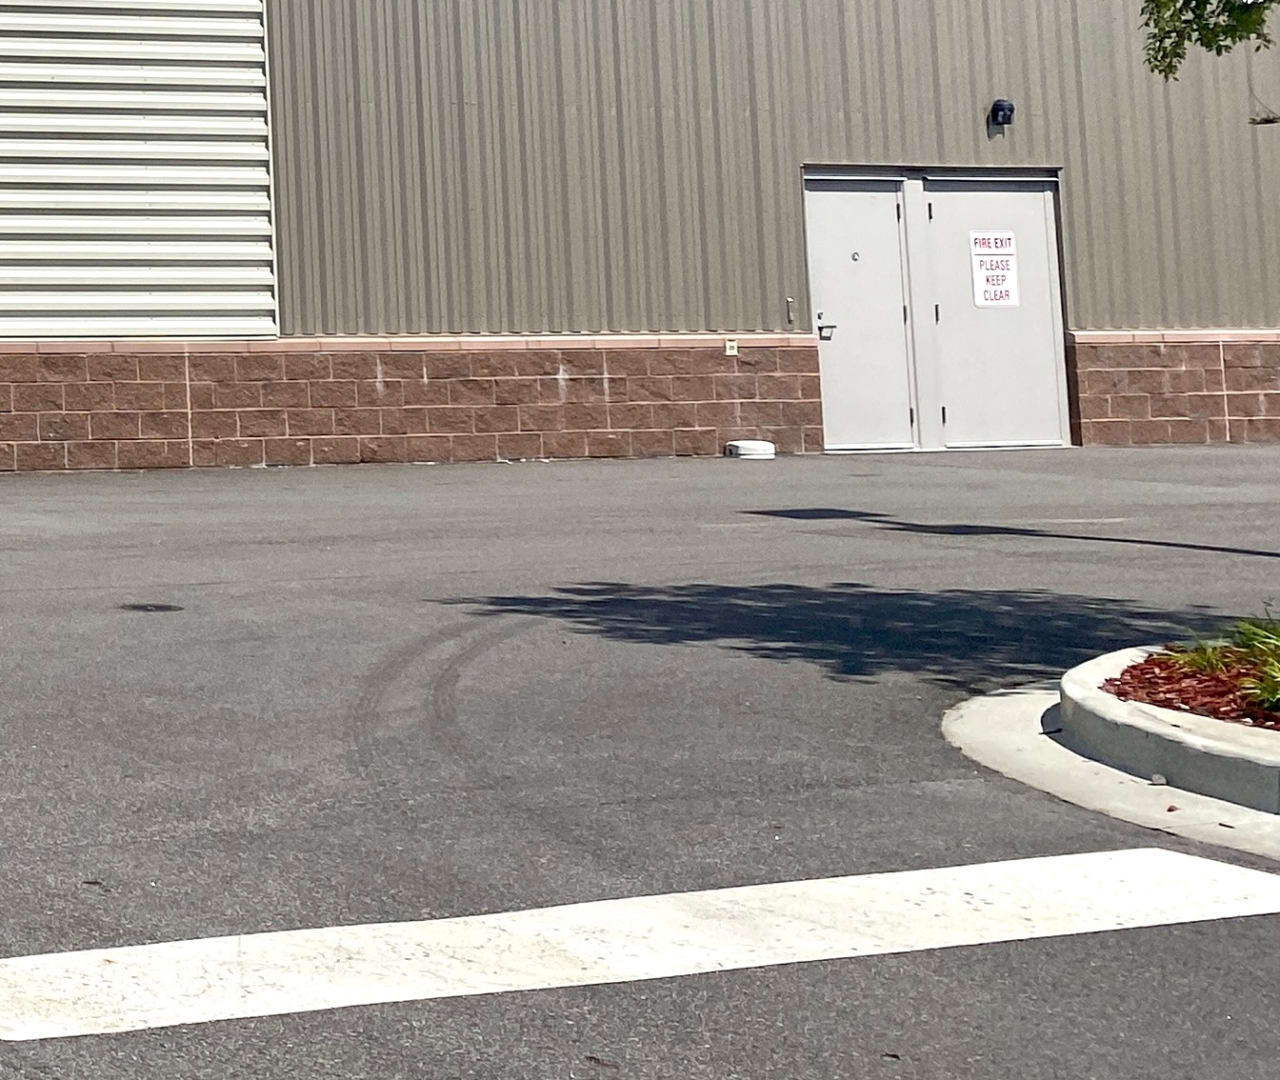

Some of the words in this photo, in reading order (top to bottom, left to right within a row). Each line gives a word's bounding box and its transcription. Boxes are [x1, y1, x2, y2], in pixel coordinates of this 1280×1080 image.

[973, 237, 992, 249] FIRE
[994, 237, 1012, 249] EXIT
[979, 259, 1011, 271] PLEASE
[985, 274, 1007, 286] KEEP
[983, 289, 1010, 301] CLEAR
